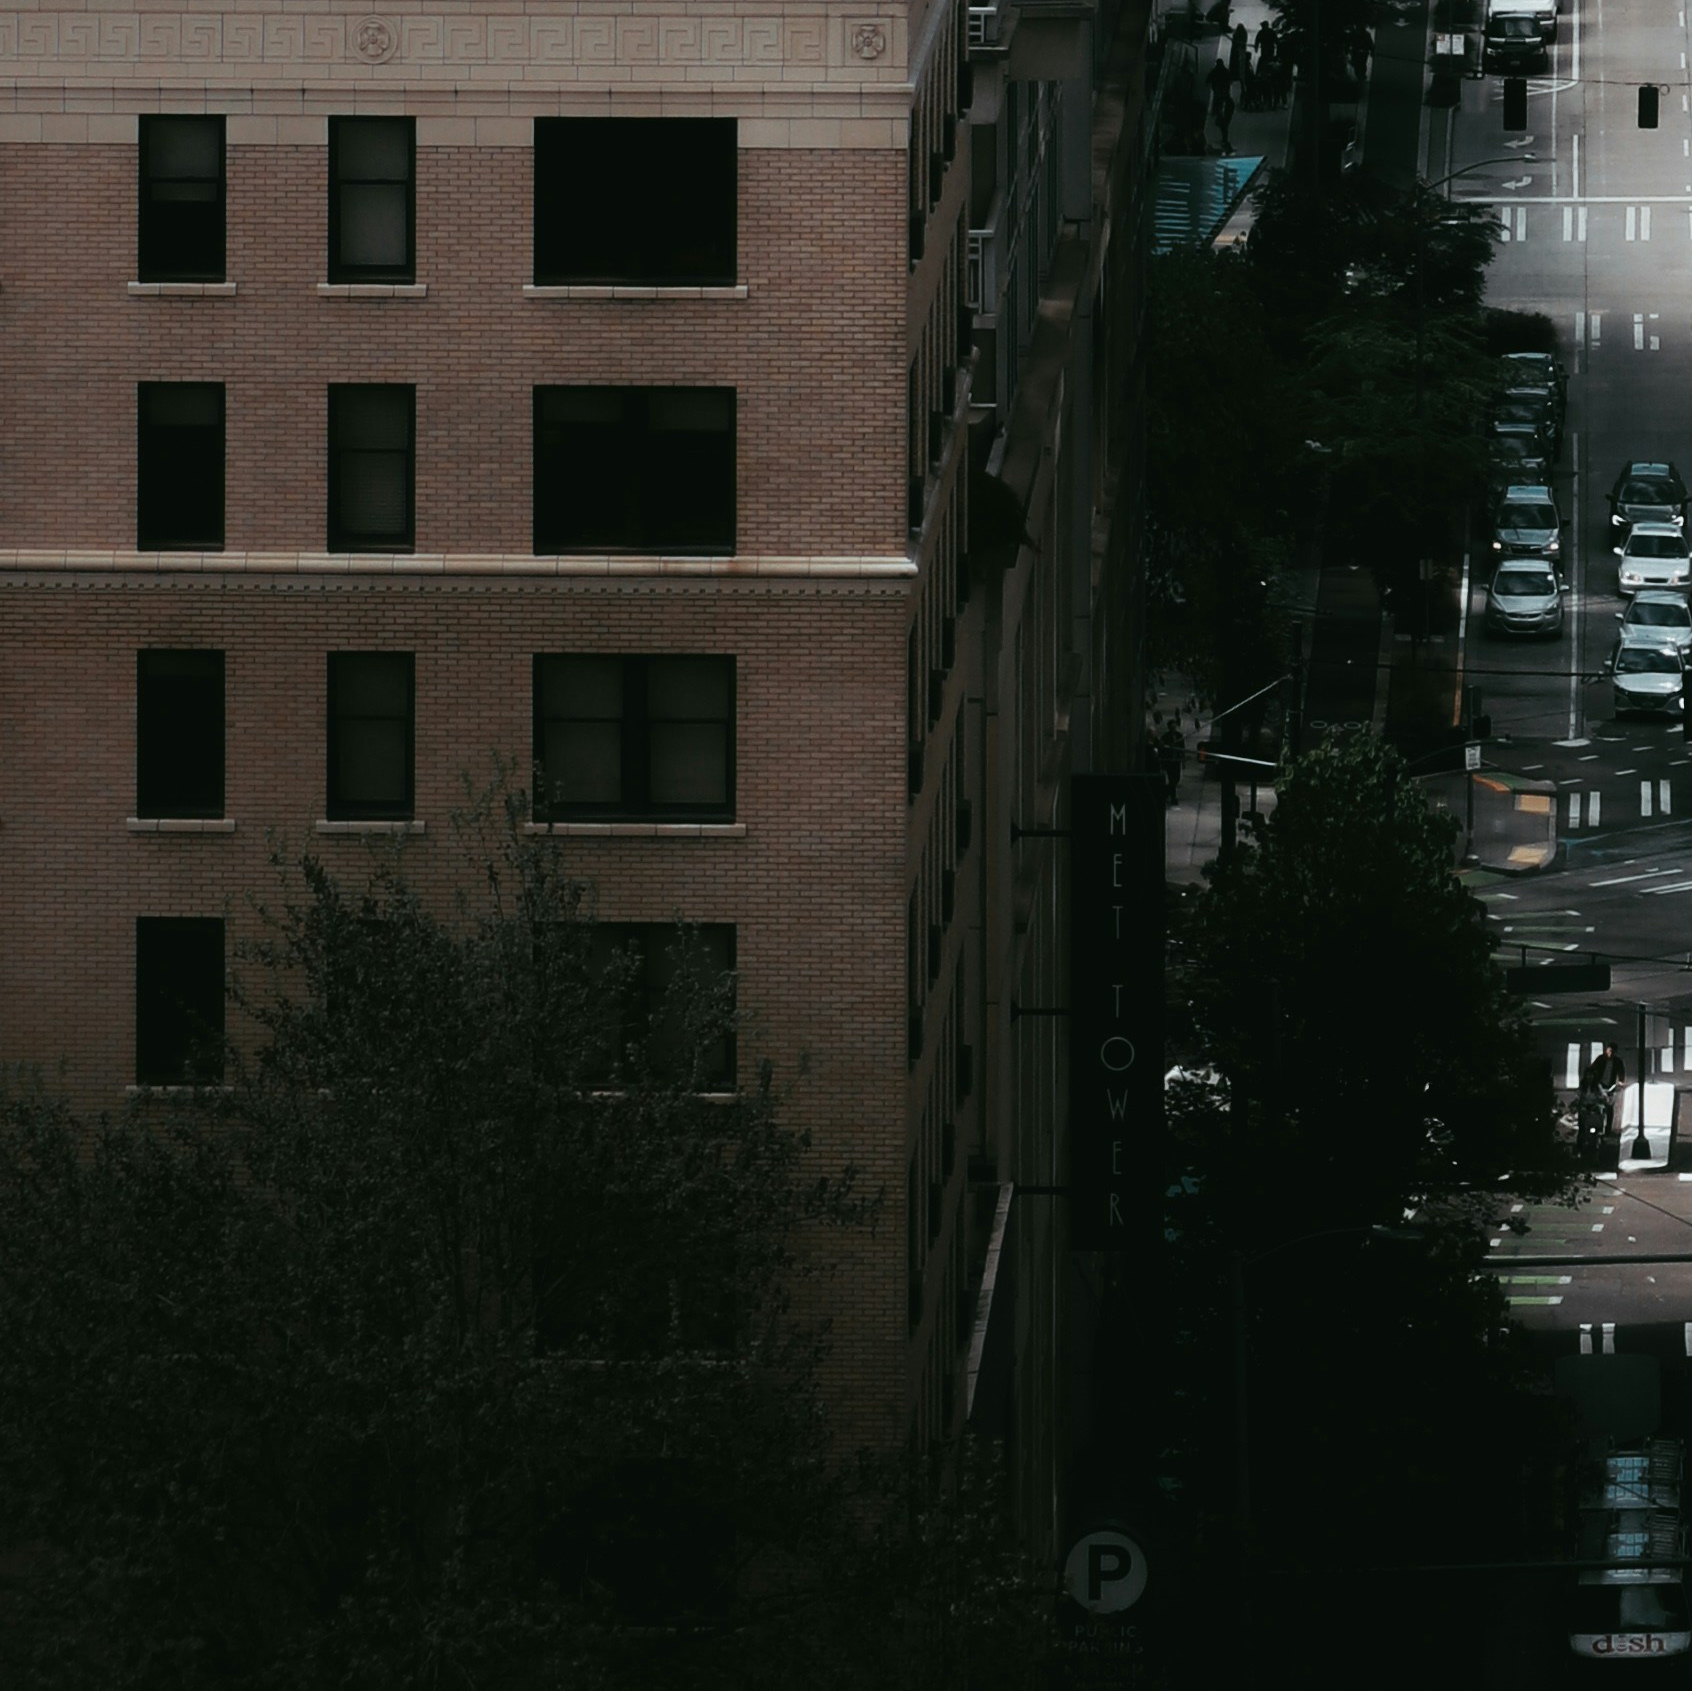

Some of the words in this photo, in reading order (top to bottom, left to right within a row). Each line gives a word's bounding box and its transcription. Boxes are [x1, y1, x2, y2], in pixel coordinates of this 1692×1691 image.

[1109, 802, 1127, 941] MET
[1100, 984, 1135, 1227] TOWER
[1088, 1544, 1132, 1601] P
[1592, 1633, 1665, 1654] dish
